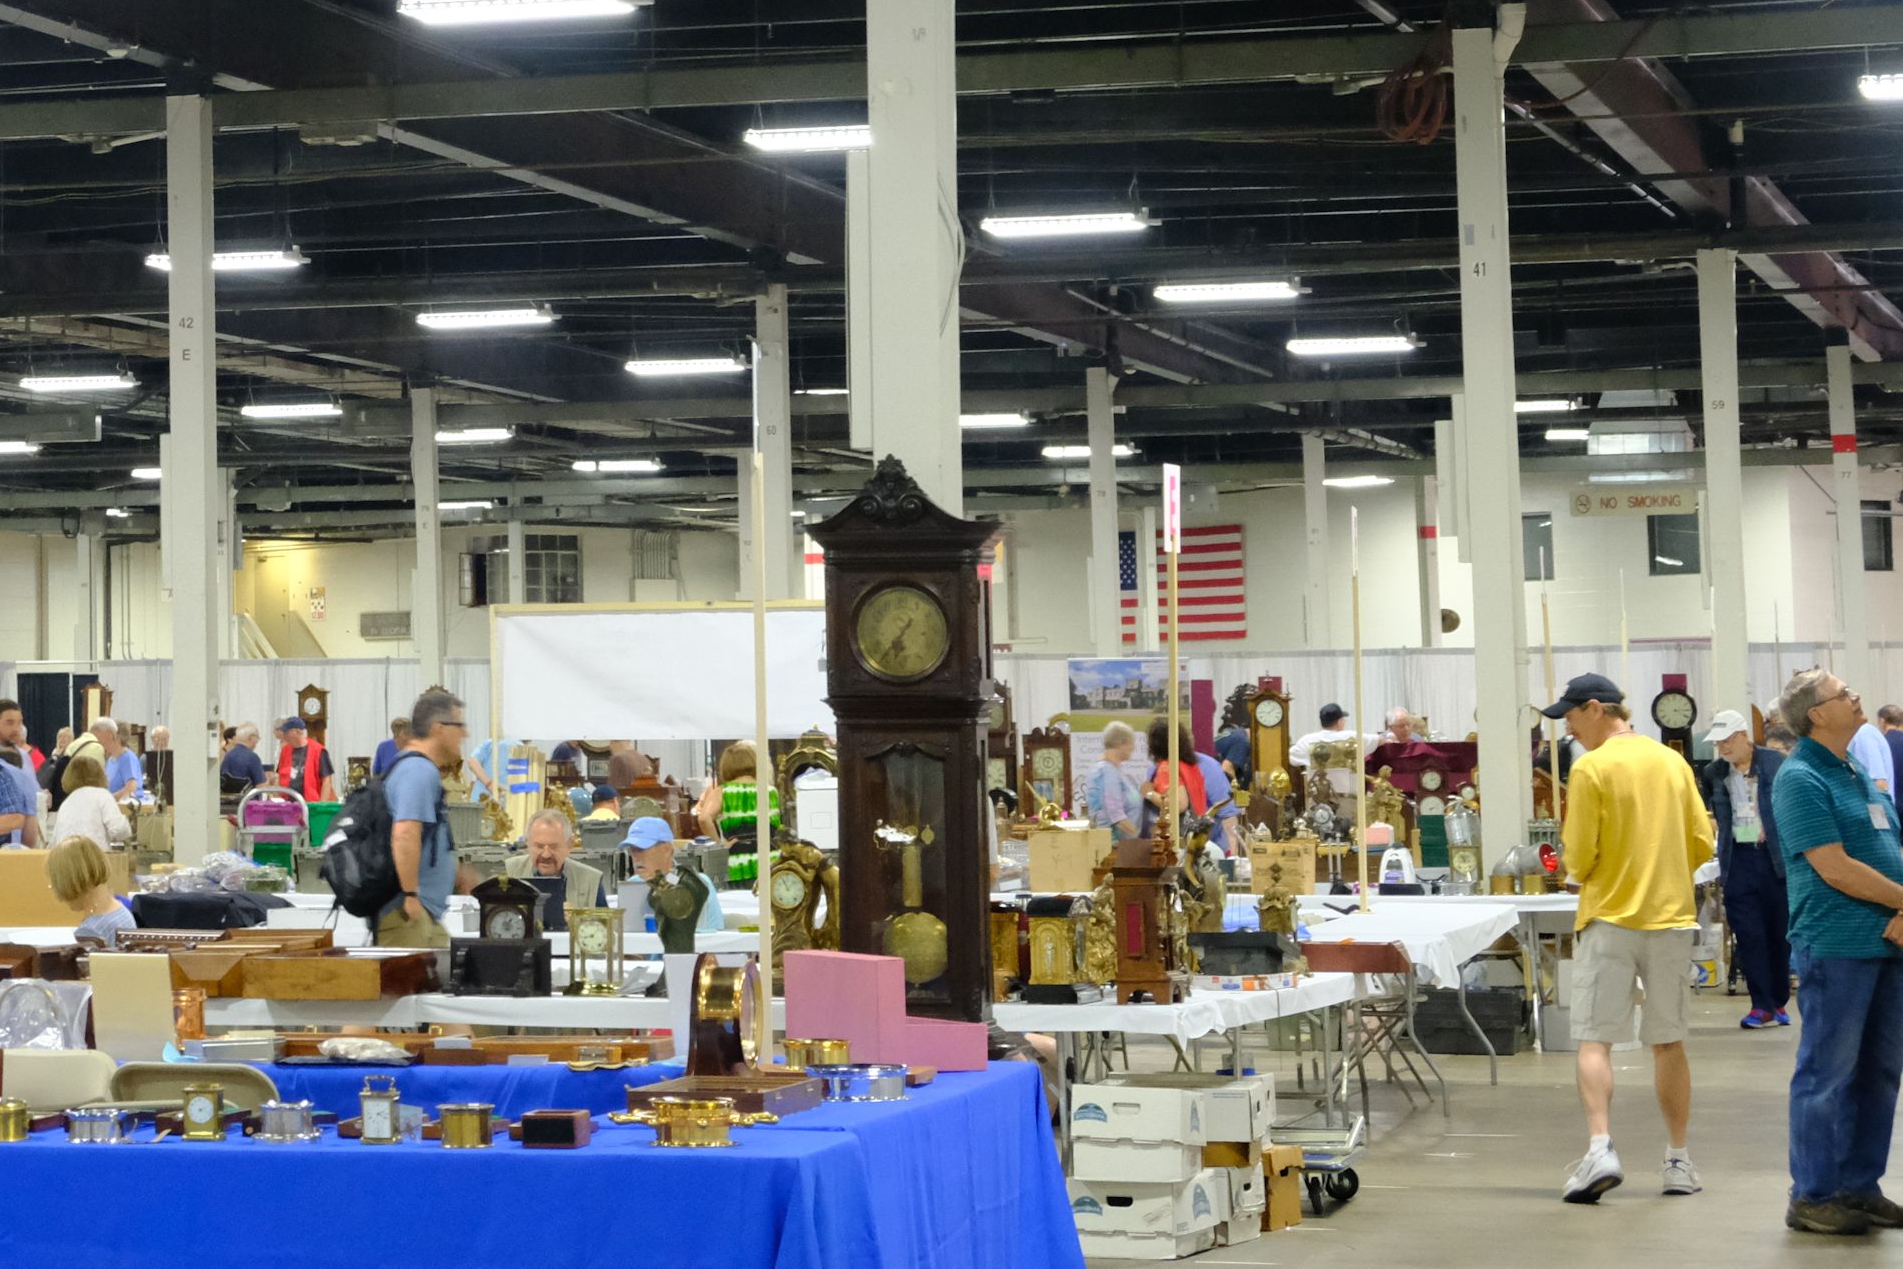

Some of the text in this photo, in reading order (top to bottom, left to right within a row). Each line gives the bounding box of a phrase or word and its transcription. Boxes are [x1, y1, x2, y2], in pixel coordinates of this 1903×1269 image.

[1473, 262, 1487, 277] 41
[178, 316, 194, 329] 42
[182, 348, 191, 361] E
[1712, 400, 1725, 409] 59
[766, 425, 777, 435] 60
[1840, 470, 1852, 479] 77
[1600, 494, 1682, 509] NO SMOKING
